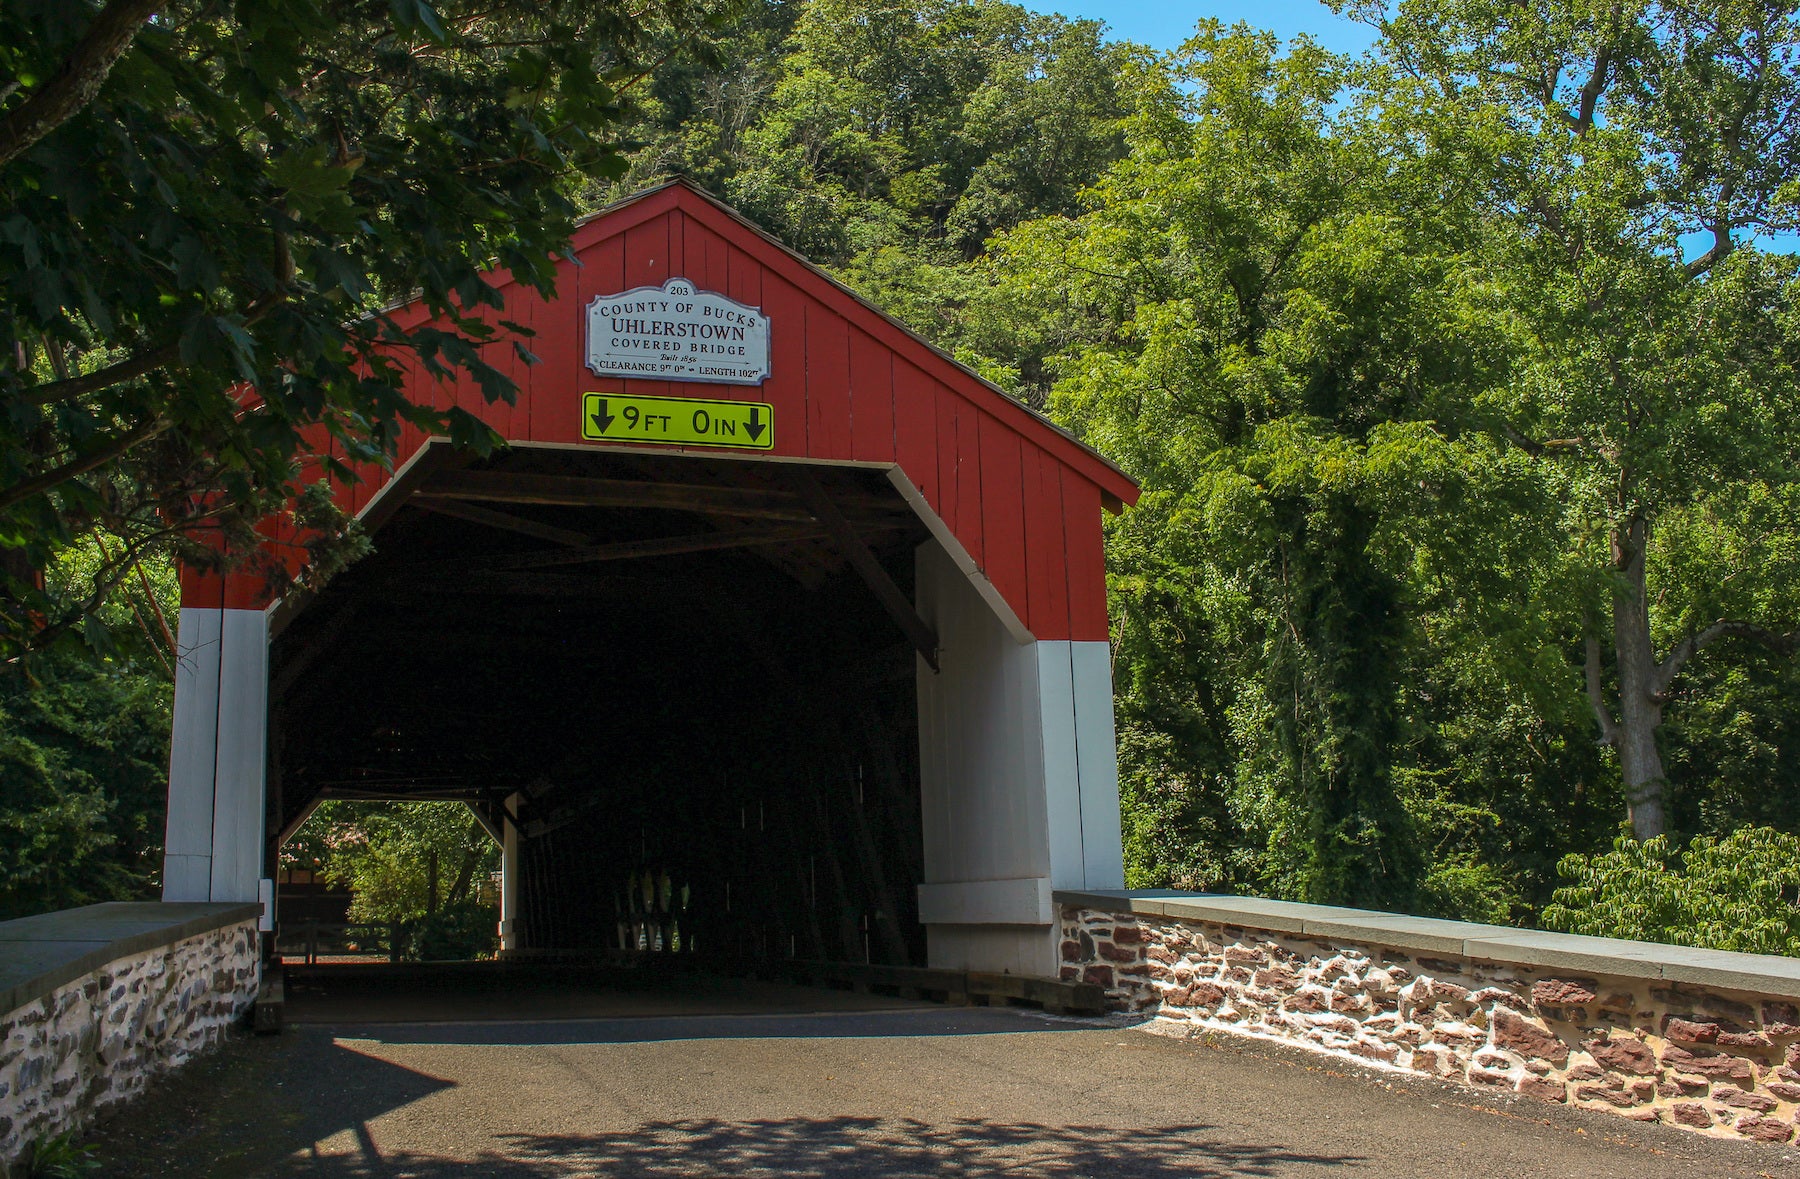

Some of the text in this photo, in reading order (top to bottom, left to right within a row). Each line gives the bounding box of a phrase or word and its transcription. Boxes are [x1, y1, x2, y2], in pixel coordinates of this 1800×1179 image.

[671, 287, 689, 296] 203
[601, 302, 756, 328] COUNTY OF BUCKS
[612, 318, 745, 341] UHLERSTOWN
[612, 338, 745, 356] COVERED BRIDGE
[660, 353, 678, 361] Built
[600, 361, 657, 371] CLEARANCE
[700, 367, 736, 377] LENGTH
